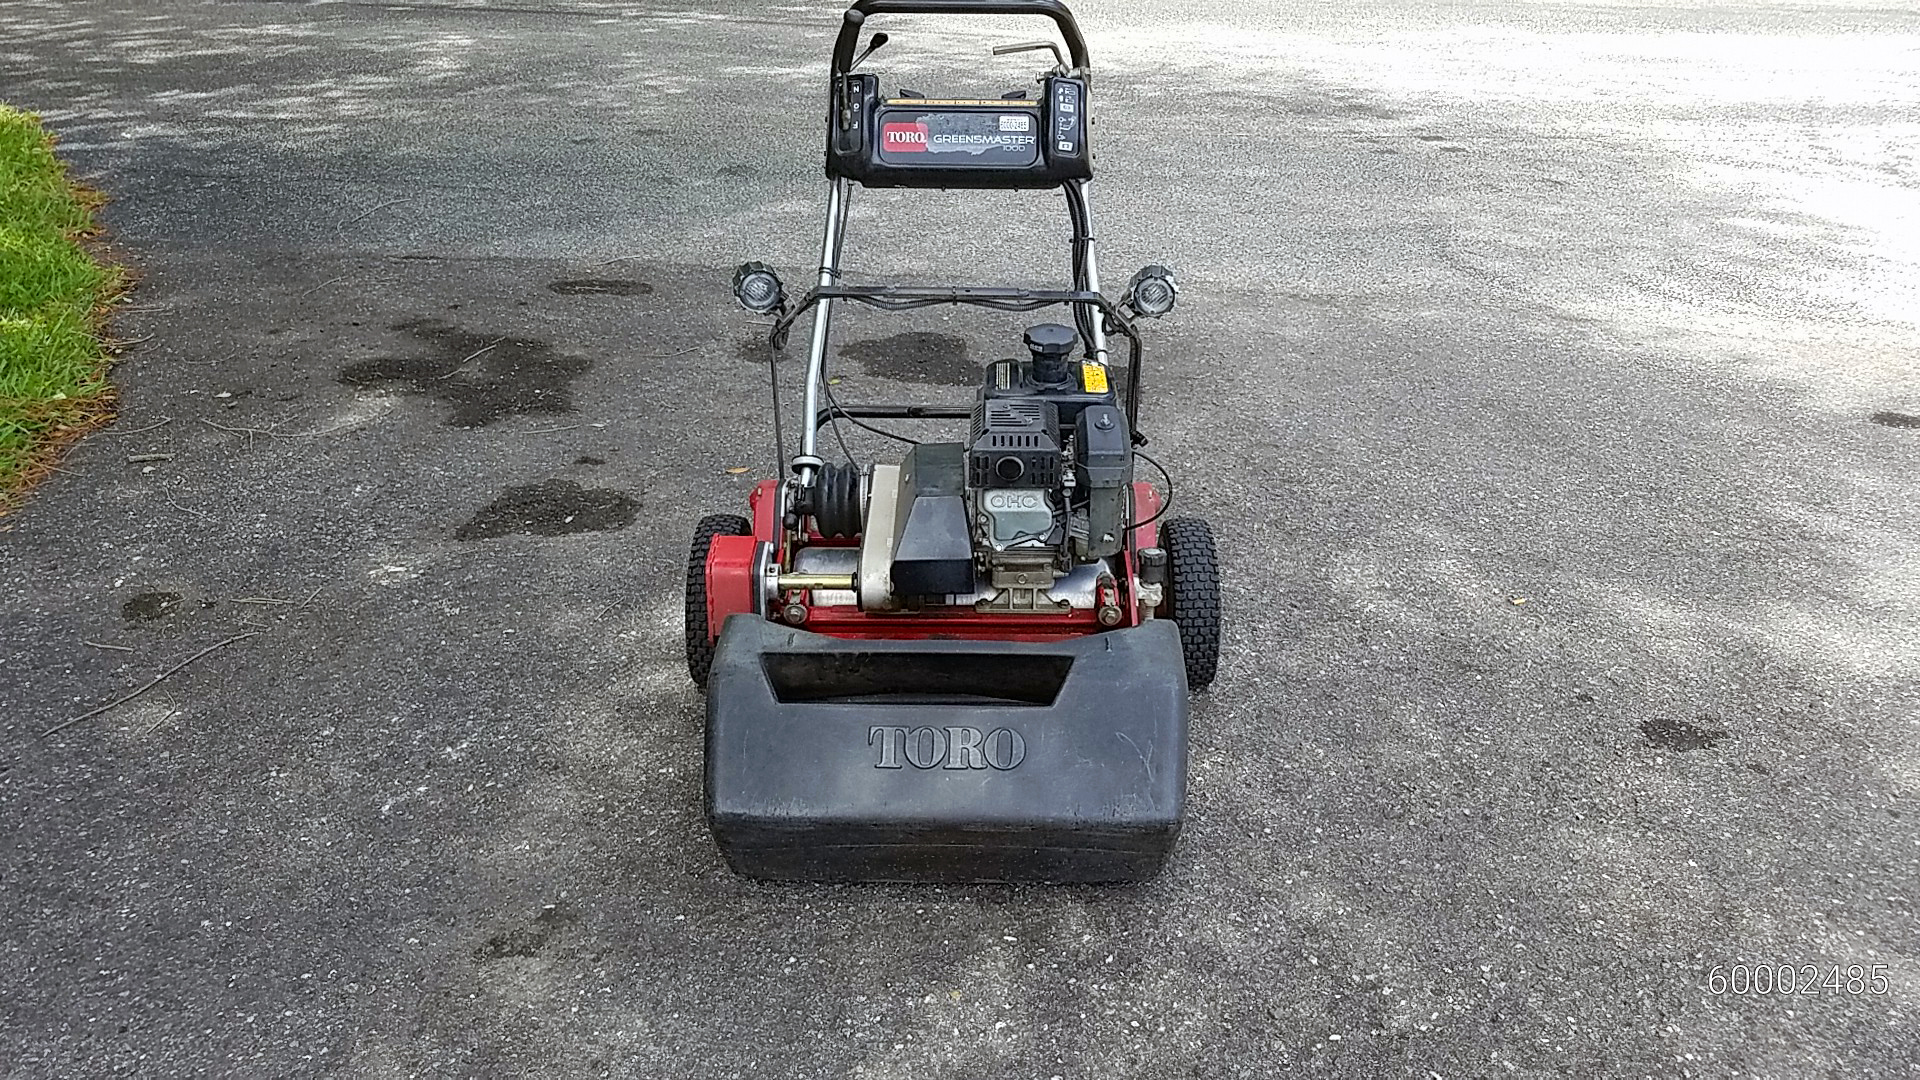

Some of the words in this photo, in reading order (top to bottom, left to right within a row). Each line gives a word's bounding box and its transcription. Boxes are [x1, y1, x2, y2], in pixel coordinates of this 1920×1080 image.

[887, 131, 926, 143] TORO
[933, 134, 1035, 144] GREENSMASTER
[991, 495, 1038, 508] OHC
[868, 725, 1026, 771] TORO
